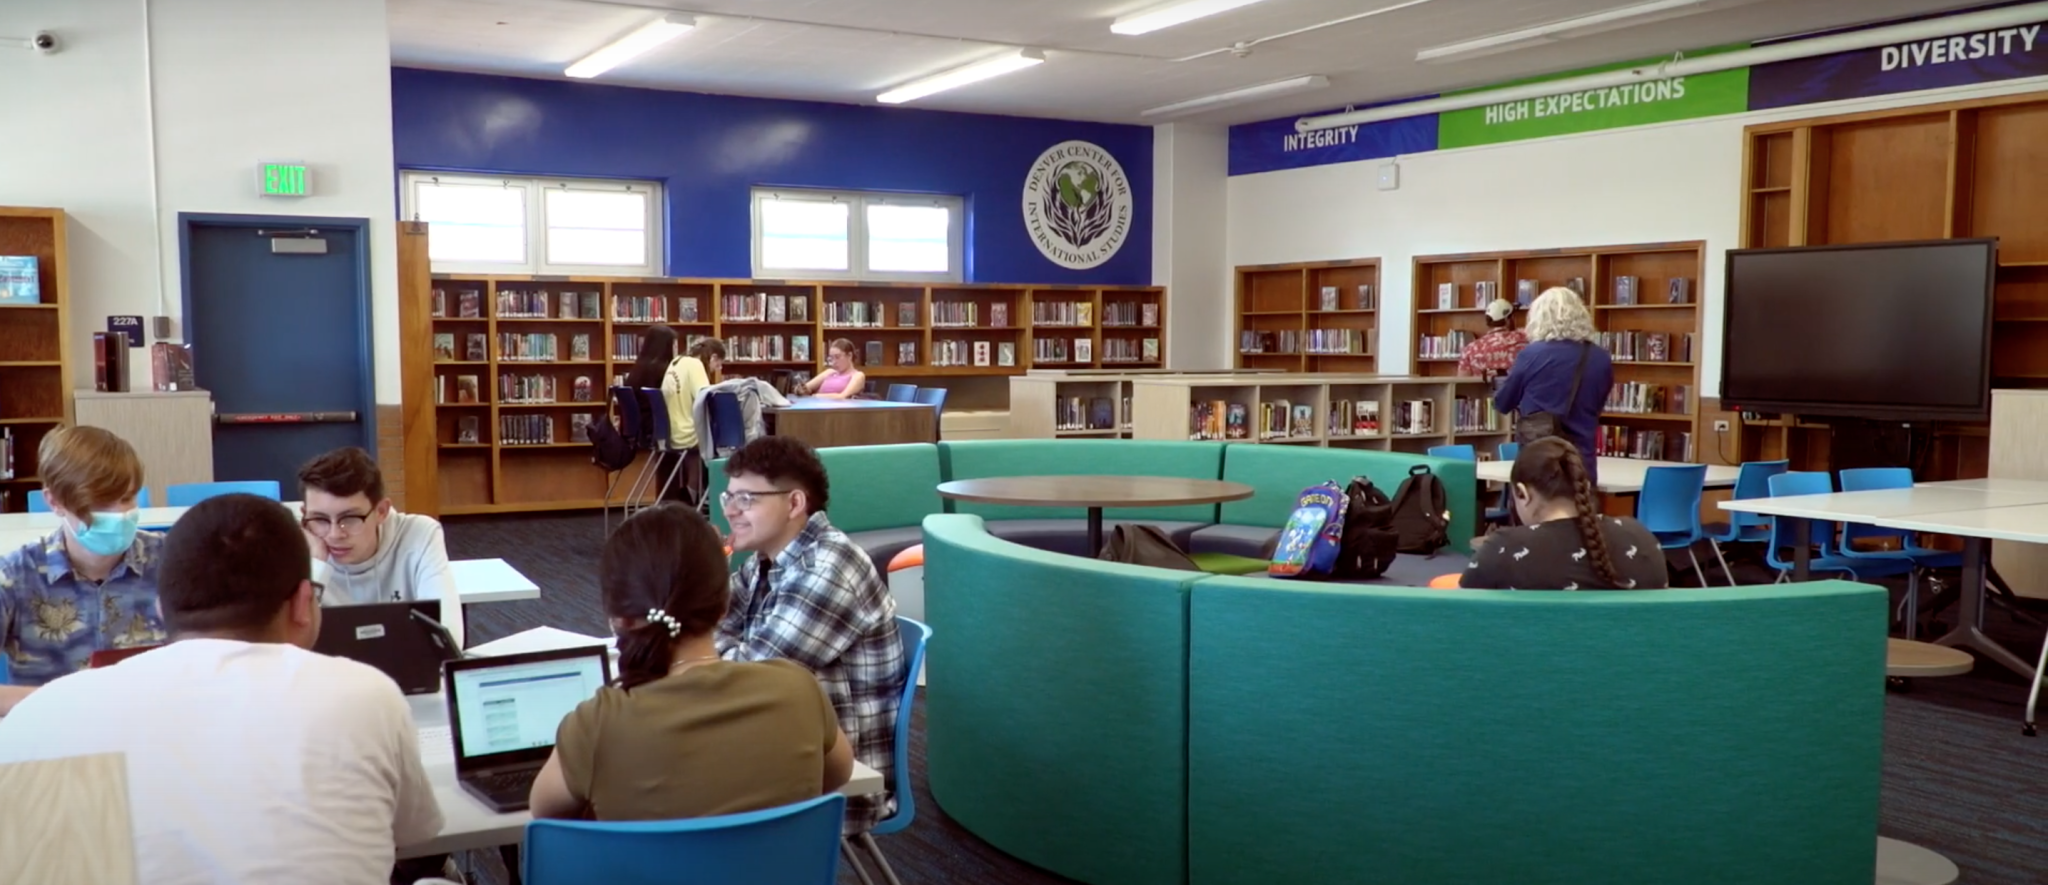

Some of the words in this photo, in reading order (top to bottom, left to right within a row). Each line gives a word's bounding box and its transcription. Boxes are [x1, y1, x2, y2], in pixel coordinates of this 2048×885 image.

[1881, 25, 2041, 71] DIVERSITY
[1485, 101, 1529, 125] HIGH
[1534, 77, 1685, 118] EXPECTATIONS
[1284, 125, 1359, 152] INTEGRITY
[265, 164, 306, 195] EXIT
[1028, 149, 1066, 192] DENVER
[1067, 146, 1112, 171] CENTER
[1111, 169, 1127, 196] FOR
[1028, 202, 1100, 264] INTERNATIONAL
[1100, 205, 1127, 256] STUDIES
[113, 317, 139, 326] 227A
